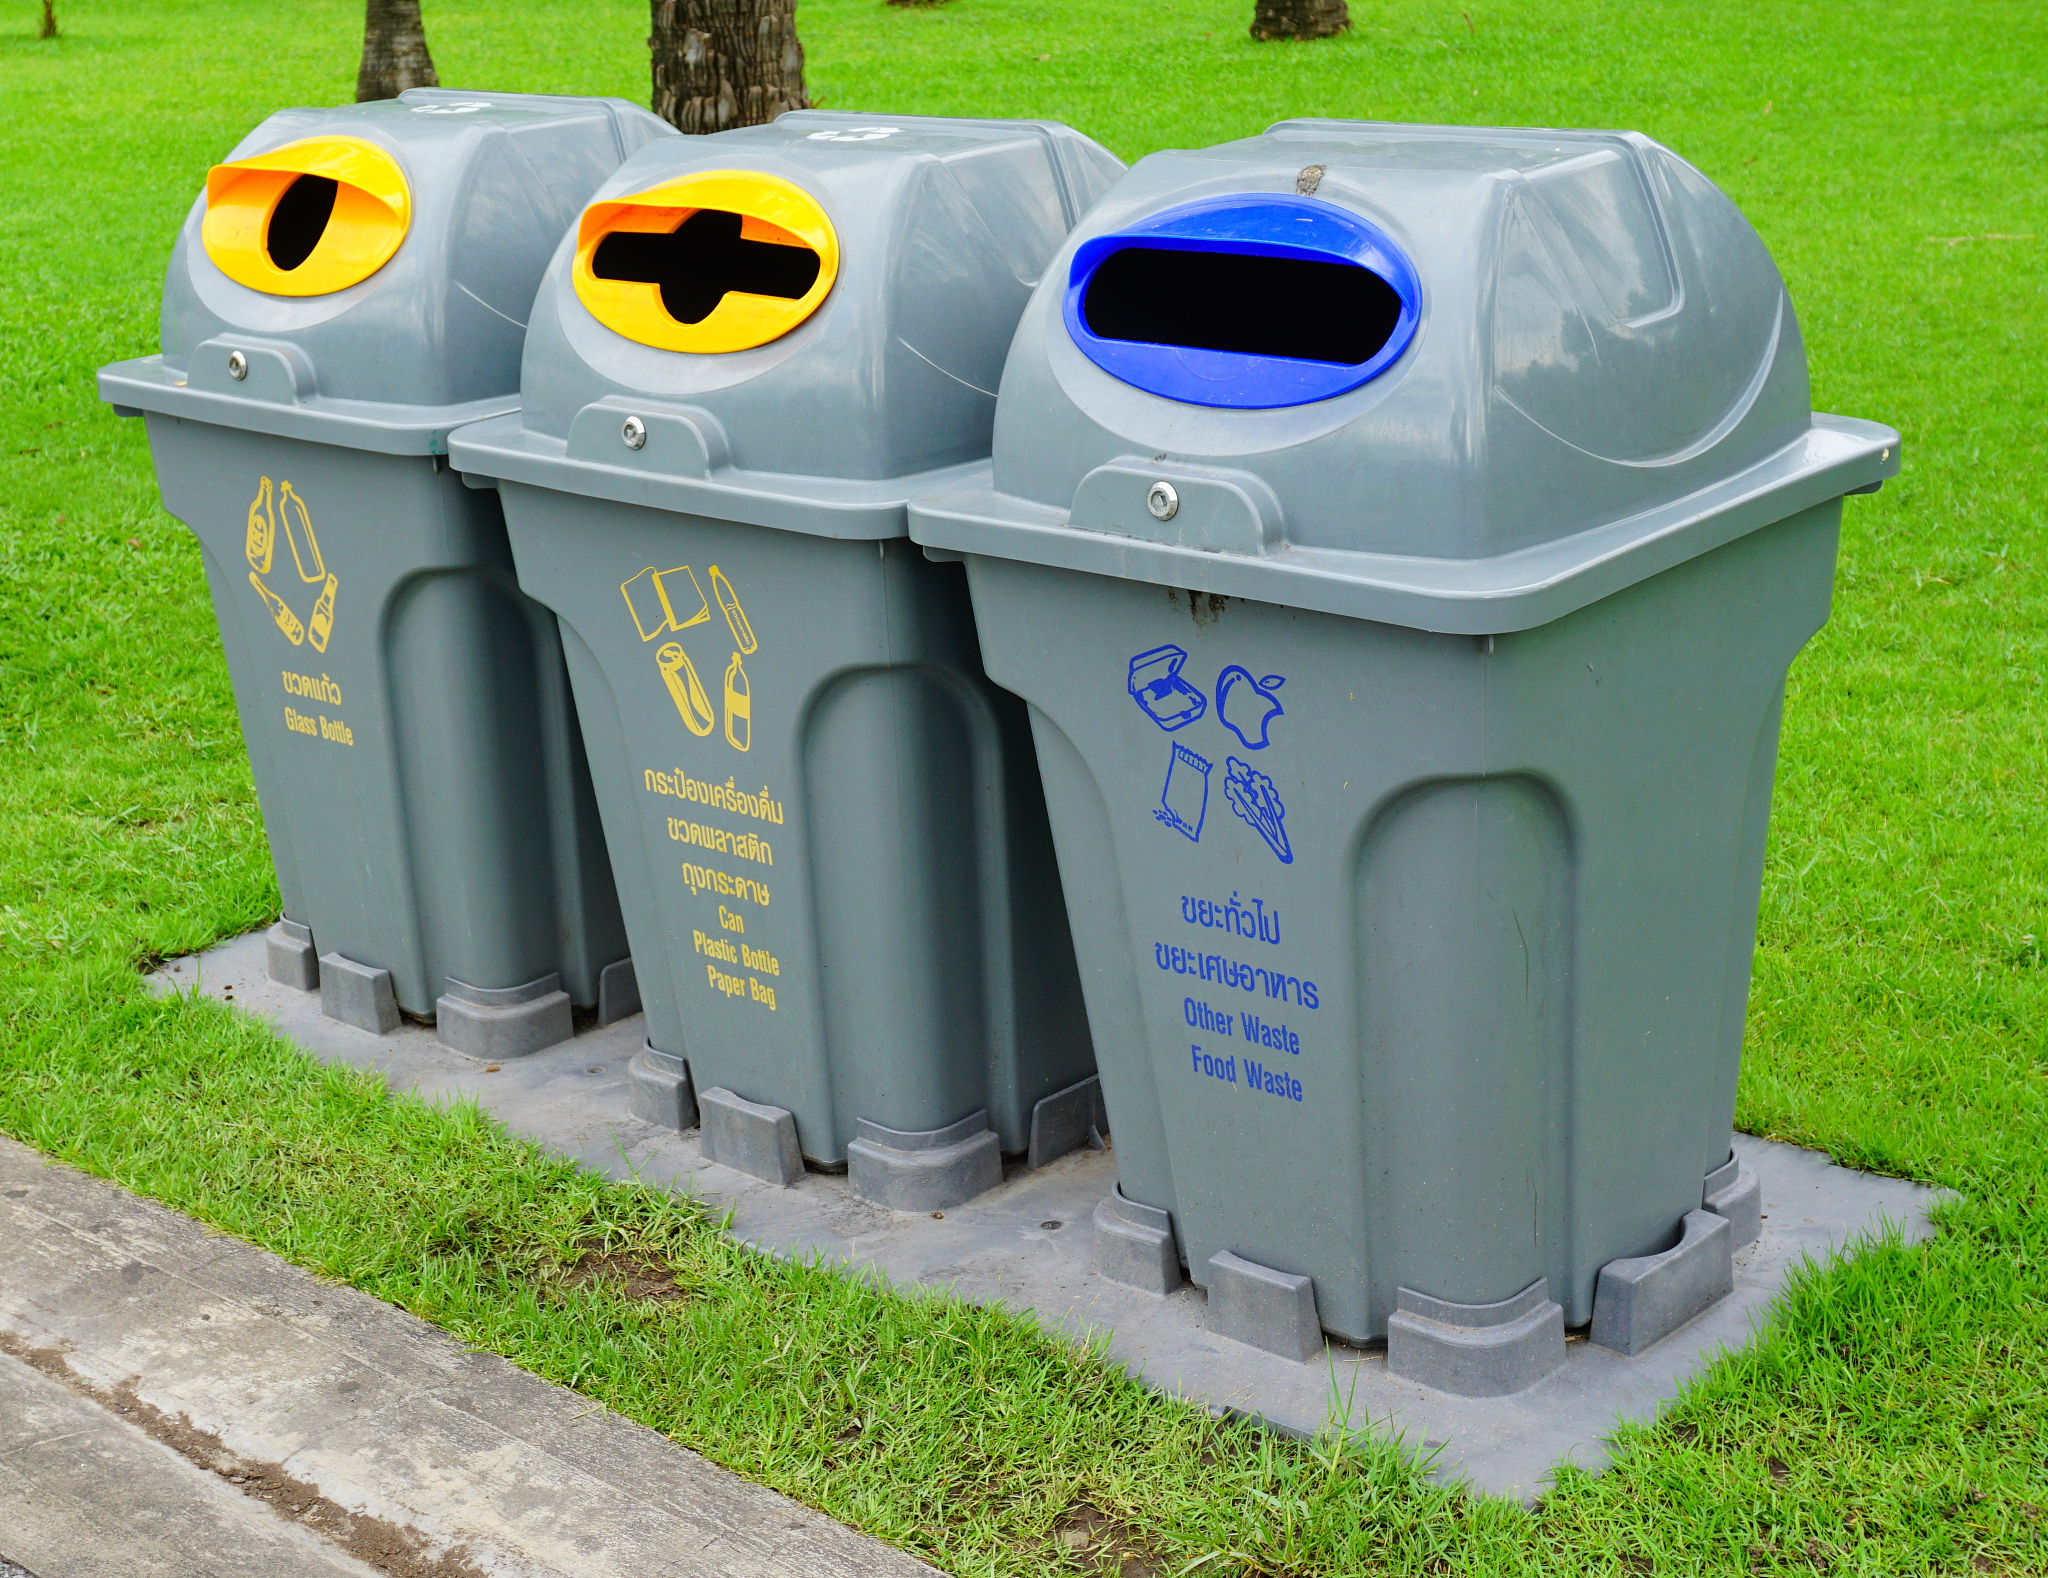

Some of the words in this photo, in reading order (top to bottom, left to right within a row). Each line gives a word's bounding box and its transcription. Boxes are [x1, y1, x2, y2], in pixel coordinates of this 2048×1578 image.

[281, 670, 341, 705] ขวดแก้ว
[283, 706, 316, 736] Glass
[319, 715, 352, 746] Bottle
[643, 766, 782, 824] กระป๋องเครื่องดื่ม
[666, 816, 772, 865] ขวดพลาสติก
[681, 862, 769, 906] ถุงกระดาษ
[718, 904, 744, 933] Can
[1180, 890, 1280, 945] ขยะทั่วไป
[692, 929, 737, 963] Plastic
[706, 964, 744, 997] Paper
[748, 976, 775, 1011] Bag
[1154, 941, 1319, 1010] ขยะเศษอาหาร
[1183, 997, 1232, 1036] Other
[1240, 1011, 1299, 1055] Waste
[1190, 1044, 1236, 1083] Food
[1243, 1058, 1302, 1102] Waste
